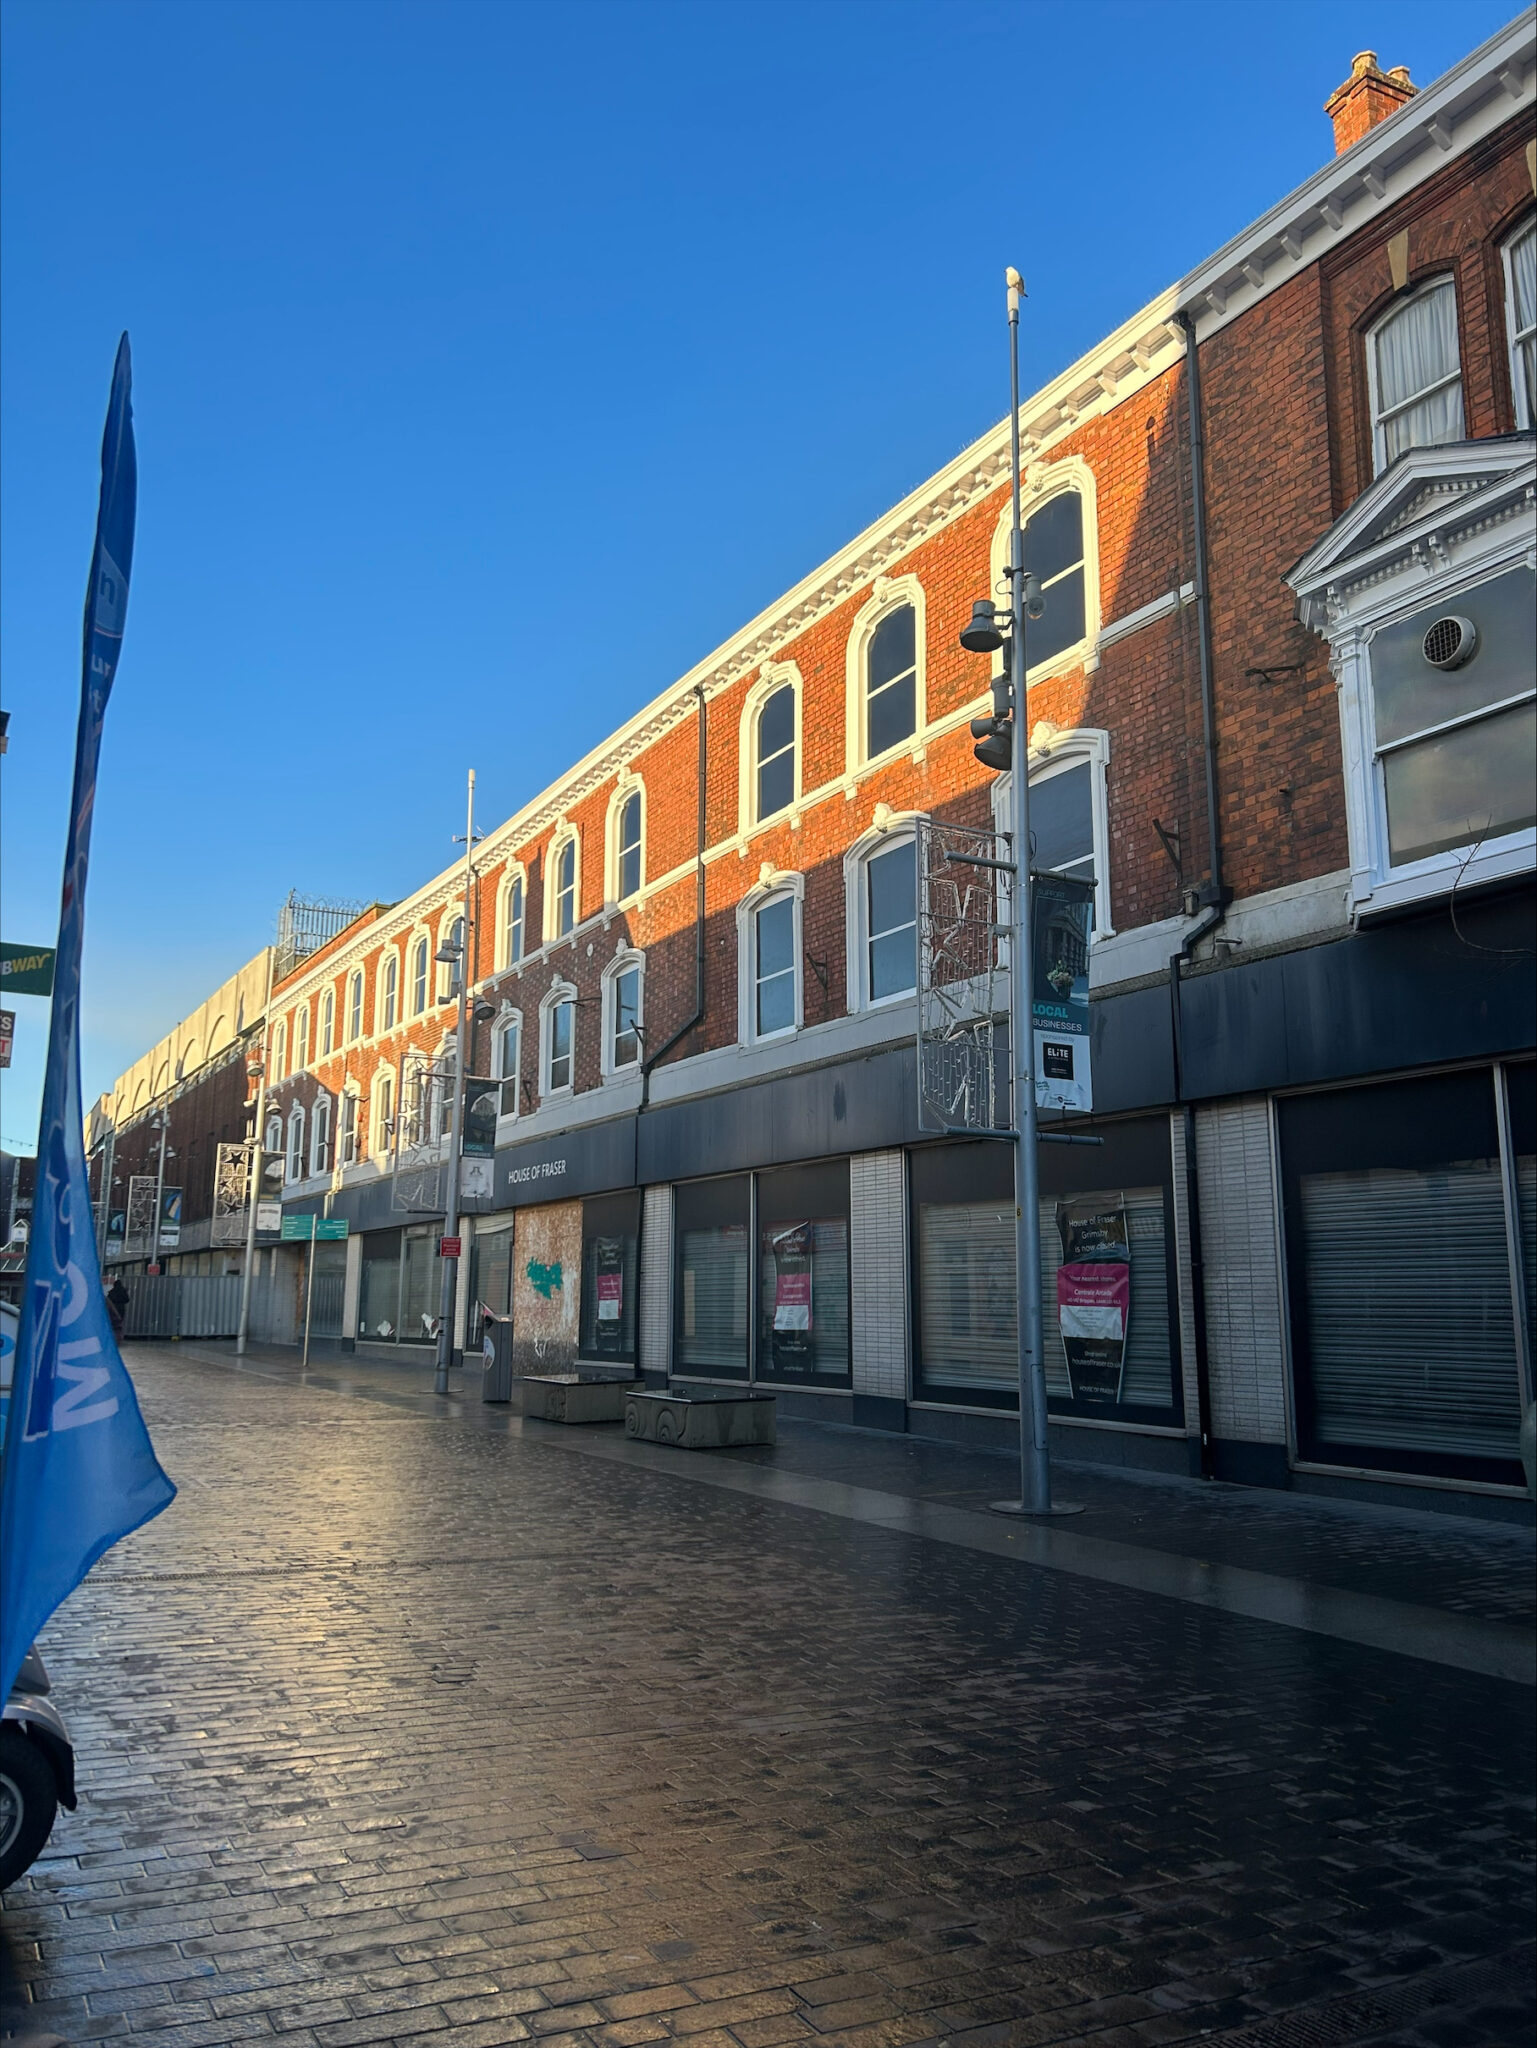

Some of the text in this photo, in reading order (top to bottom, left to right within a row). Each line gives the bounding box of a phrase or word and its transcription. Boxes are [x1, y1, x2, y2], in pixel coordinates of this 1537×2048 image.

[1032, 1003, 1069, 1018] LOCAL
[1032, 1018, 1082, 1032] BUSINESSES
[508, 1159, 567, 1184] HOUSE OF FRASER
[1068, 1215, 1117, 1227] House of Fraser
[1081, 1230, 1109, 1240] Grimsby
[1081, 1244, 1095, 1252] now
